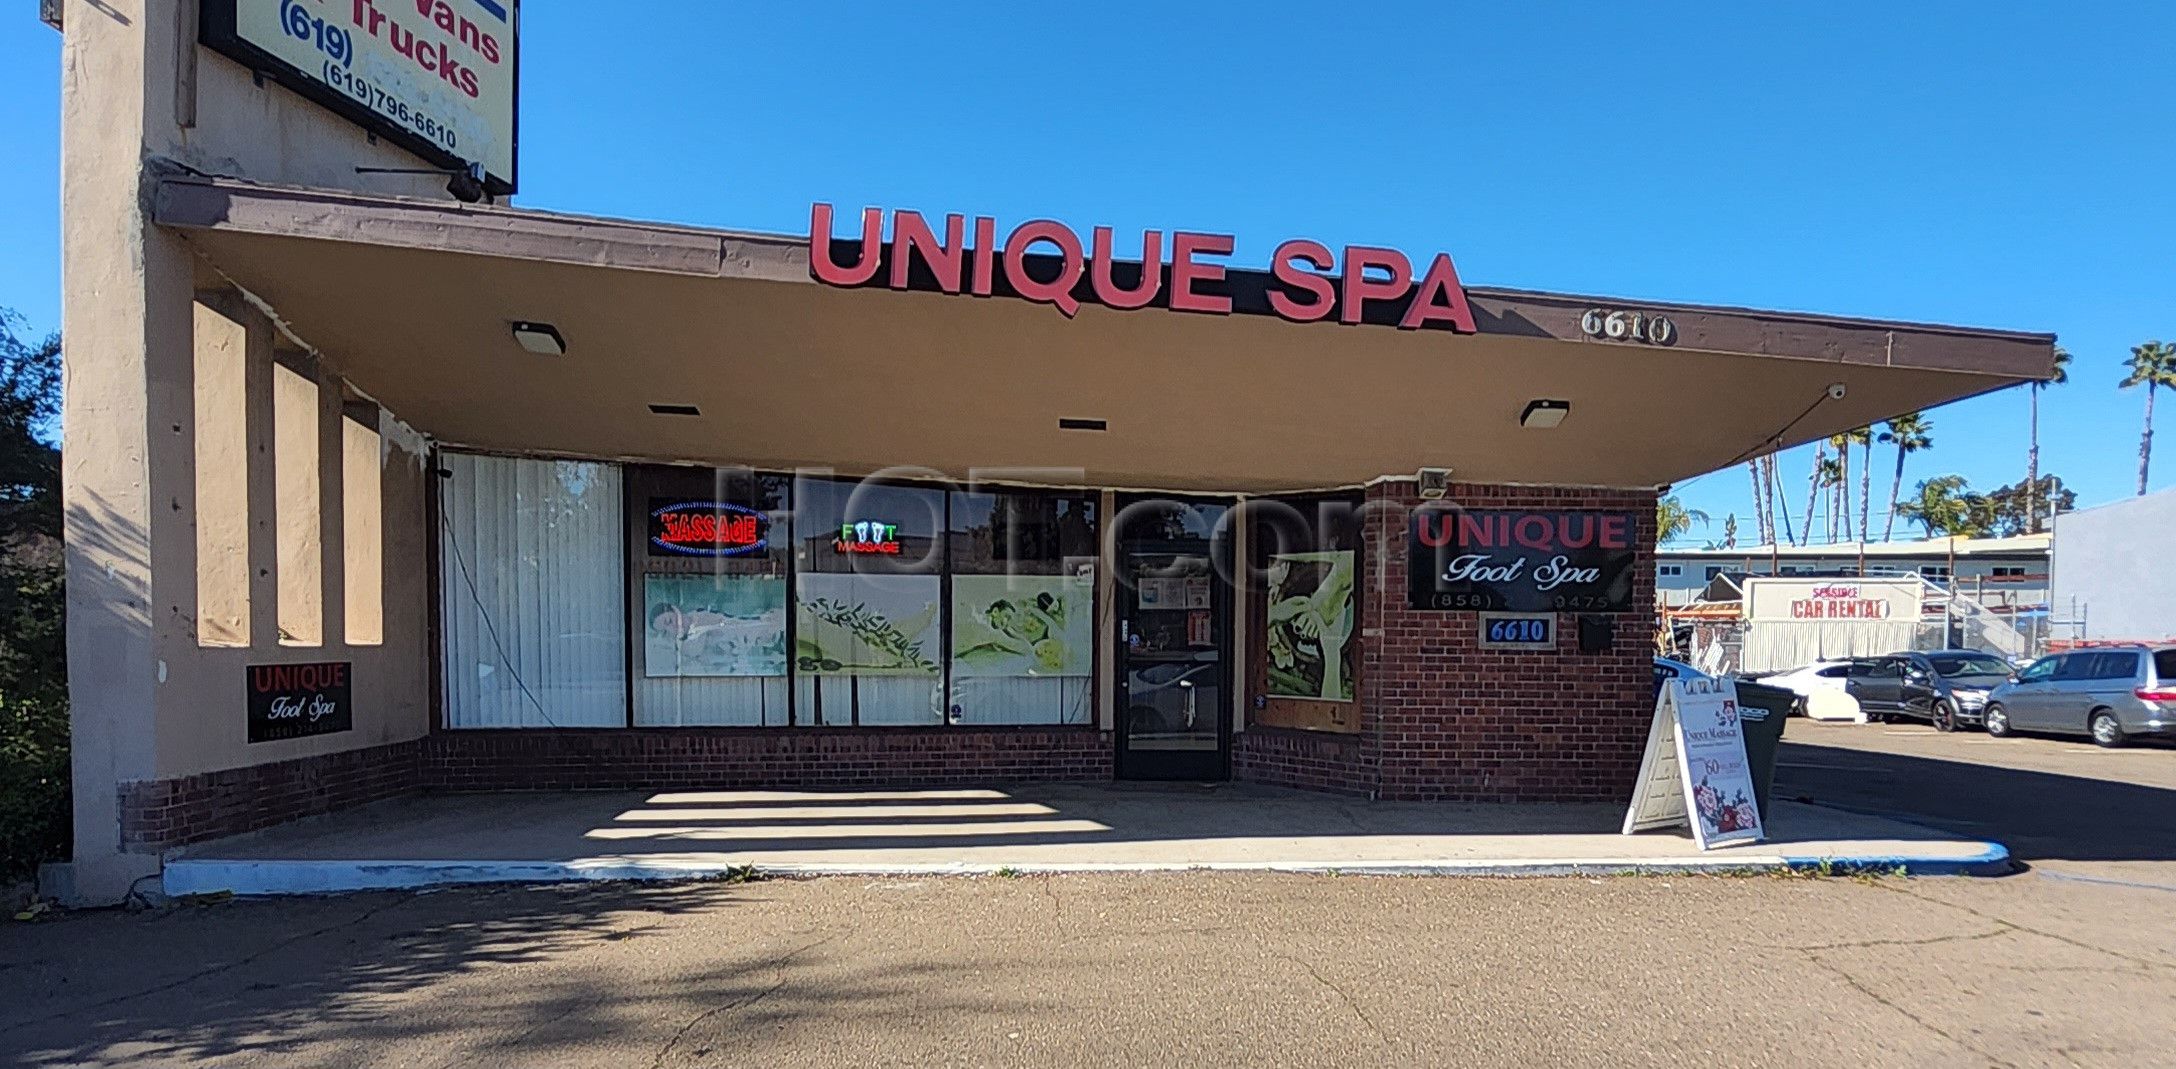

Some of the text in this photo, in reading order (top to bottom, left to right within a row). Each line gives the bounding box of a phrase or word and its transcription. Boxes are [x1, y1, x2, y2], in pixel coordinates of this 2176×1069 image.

[280, 0, 353, 68] (619)
[352, 0, 480, 98] Trucks
[413, 0, 501, 64] Vans
[323, 60, 457, 149] (619)796-6610
[809, 202, 1477, 335] UNIQUE SPA
[1581, 308, 1674, 345] 6610
[661, 513, 757, 544] MASSAGE
[1418, 514, 1627, 553] UNIQUE
[838, 541, 900, 553] MASSAGE
[1442, 554, 1600, 590] Foot Spa
[1431, 595, 1493, 609] (858)
[1793, 600, 1882, 618] CAR RENTAL
[1491, 620, 1544, 641] 6610
[255, 664, 344, 692] UNIQUE
[268, 694, 336, 722] Foot Spa
